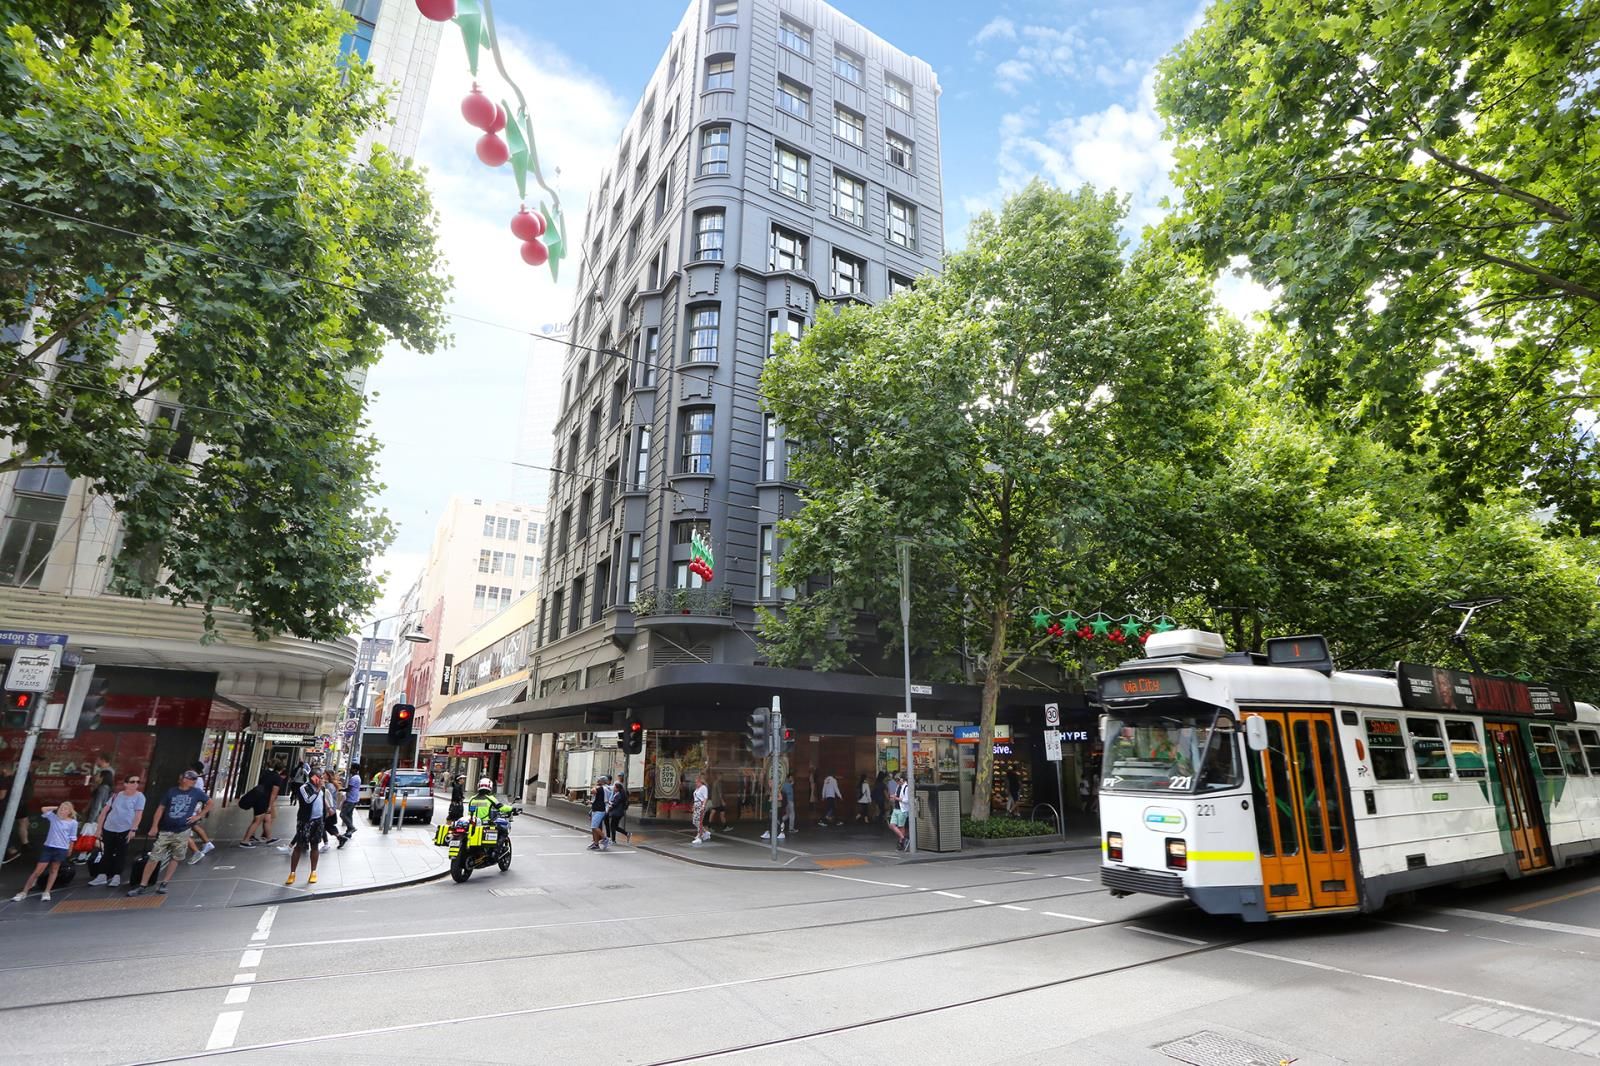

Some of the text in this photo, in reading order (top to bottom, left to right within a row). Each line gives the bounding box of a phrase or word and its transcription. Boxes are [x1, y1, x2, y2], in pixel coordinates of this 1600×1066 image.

[27, 633, 39, 642] St
[1123, 678, 1161, 693] via City
[1047, 710, 1057, 719] 30
[256, 720, 311, 730] WATCHMAKER
[962, 731, 980, 739] health
[1059, 731, 1088, 740] HYPE
[1169, 776, 1193, 790] 221
[1196, 804, 1216, 817] 221
